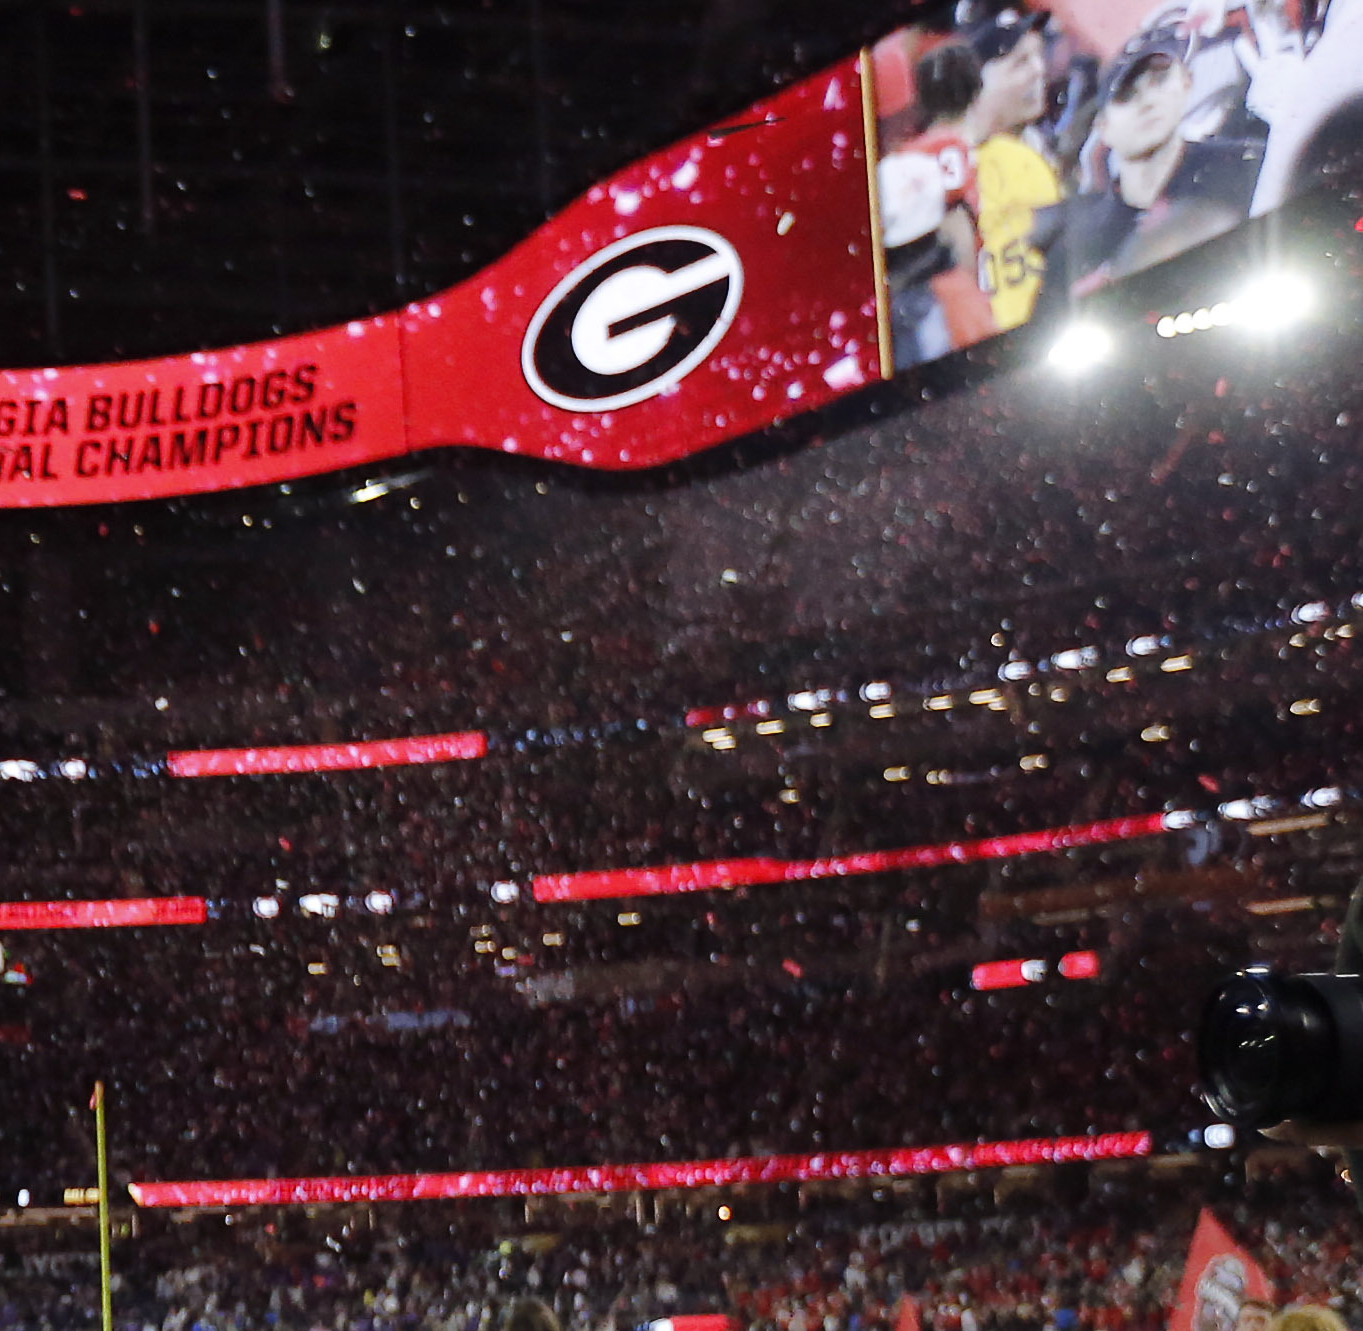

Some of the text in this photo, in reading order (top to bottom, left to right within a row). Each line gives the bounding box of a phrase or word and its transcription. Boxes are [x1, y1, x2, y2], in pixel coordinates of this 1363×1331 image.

[564, 247, 739, 383] G
[85, 363, 318, 432] BULLDOGS
[75, 401, 358, 477] CHAMPIONS
